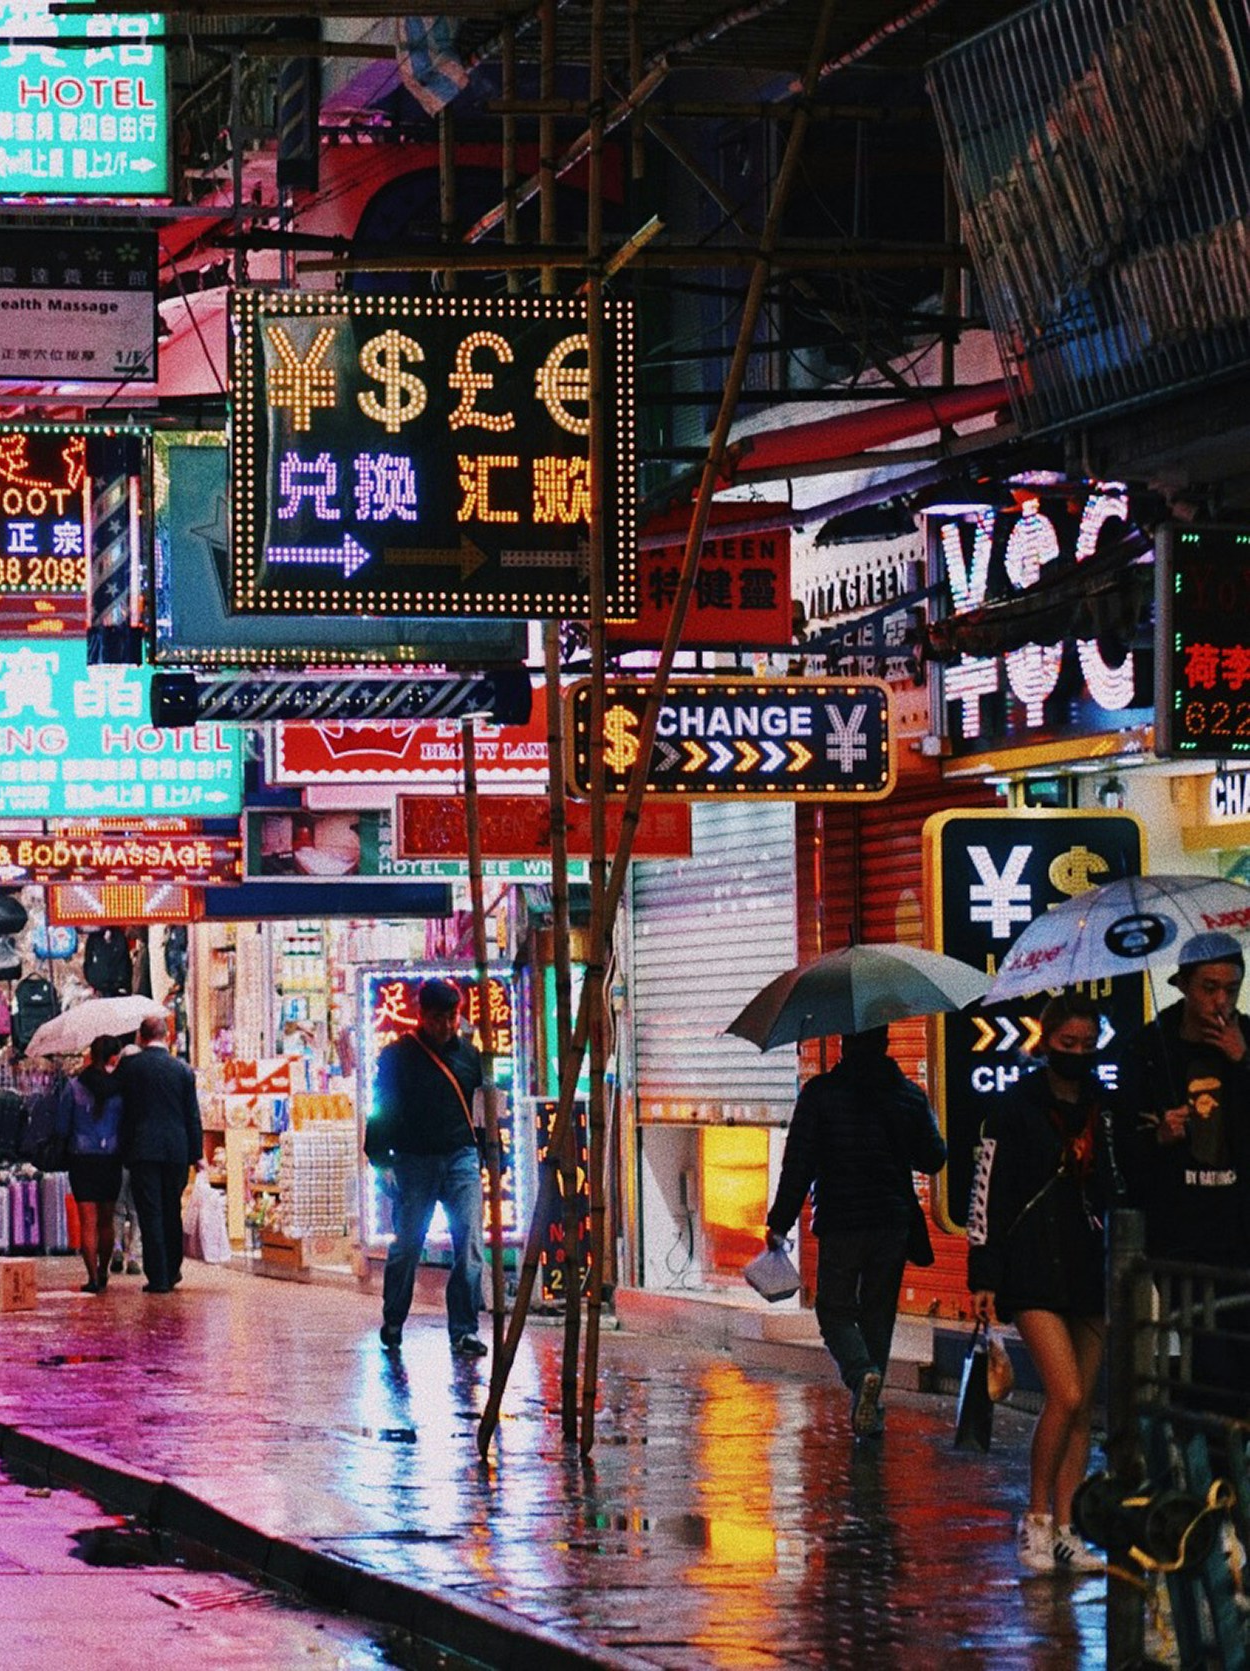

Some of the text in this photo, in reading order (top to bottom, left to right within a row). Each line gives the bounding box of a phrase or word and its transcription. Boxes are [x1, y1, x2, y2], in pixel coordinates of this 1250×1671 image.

[17, 75, 156, 109] HOTEL
[48, 300, 119, 315] Massage
[7, 521, 83, 554] 正宗
[680, 539, 775, 559] REEN
[656, 706, 812, 736] CHANGE
[101, 724, 233, 752] HOTEL
[503, 742, 548, 760] LAN
[18, 844, 86, 867] BODY
[91, 845, 212, 867] MASSAGE
[378, 861, 444, 874] HOTEL
[458, 860, 510, 874] FEE
[971, 1064, 1119, 1093] CHE
